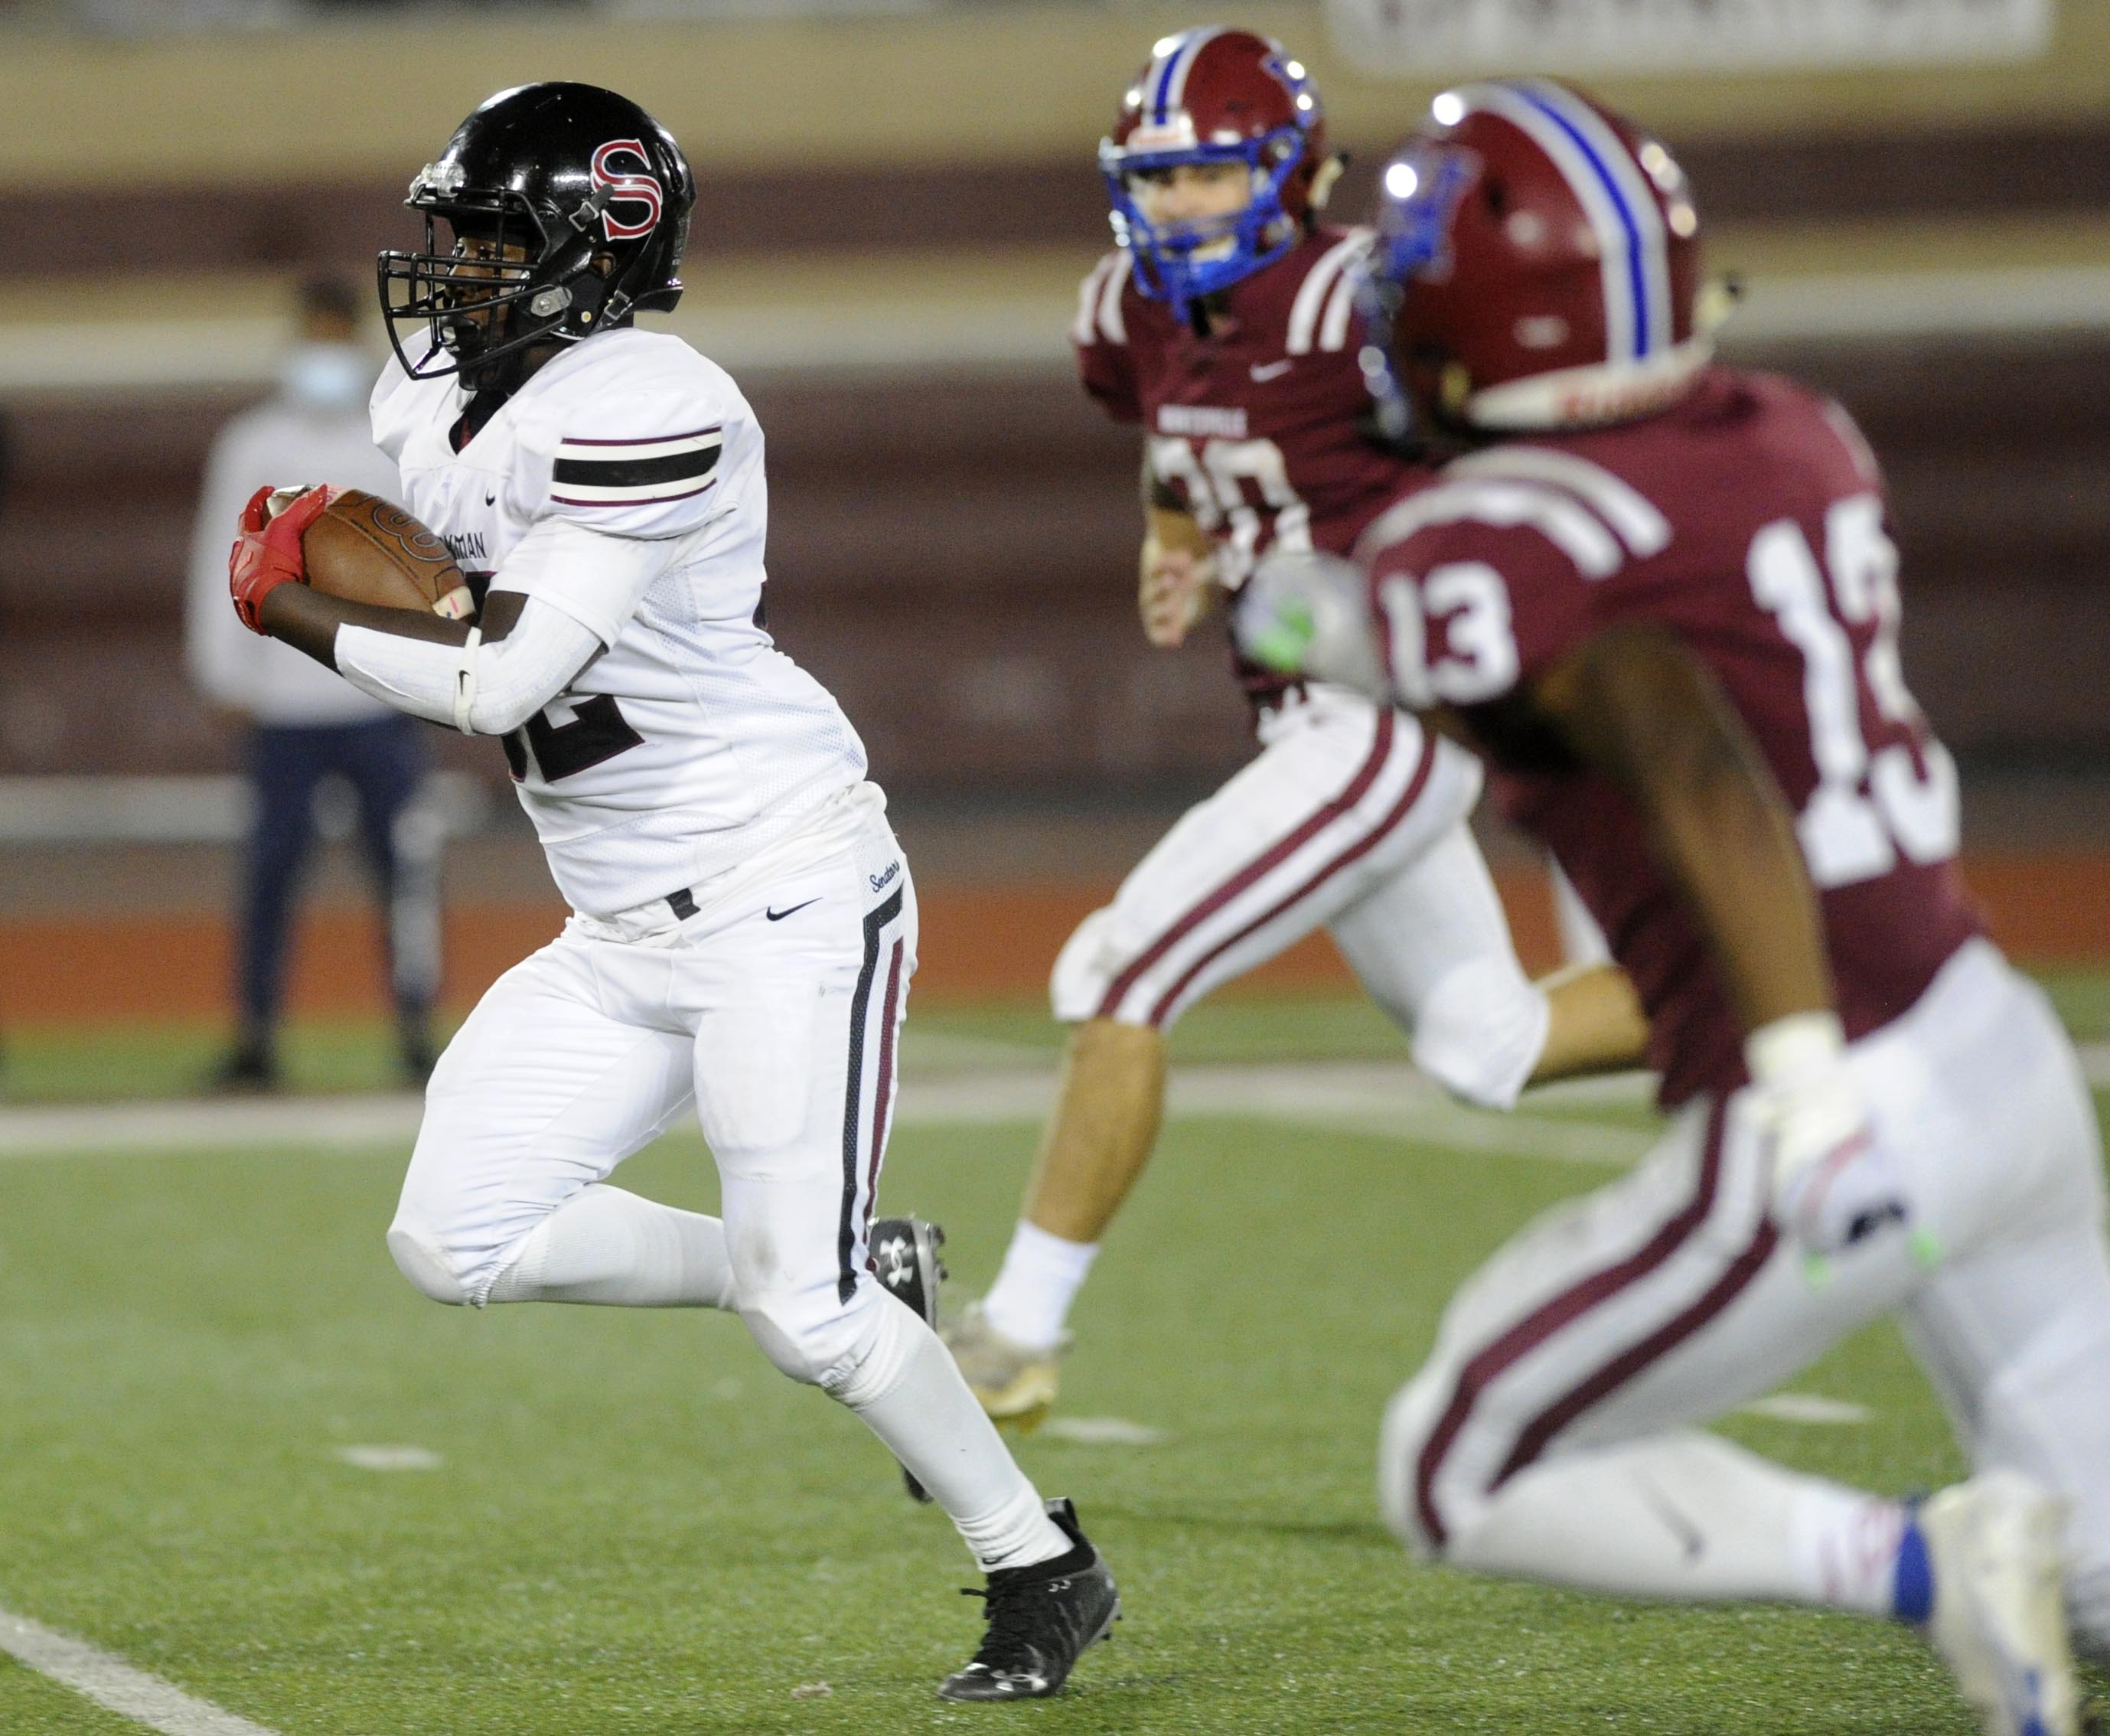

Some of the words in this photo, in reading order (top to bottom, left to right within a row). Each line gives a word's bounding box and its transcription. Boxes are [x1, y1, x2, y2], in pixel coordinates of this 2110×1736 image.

[590, 139, 663, 242] S
[440, 532, 487, 560] KMAN
[1378, 560, 1521, 709] 13
